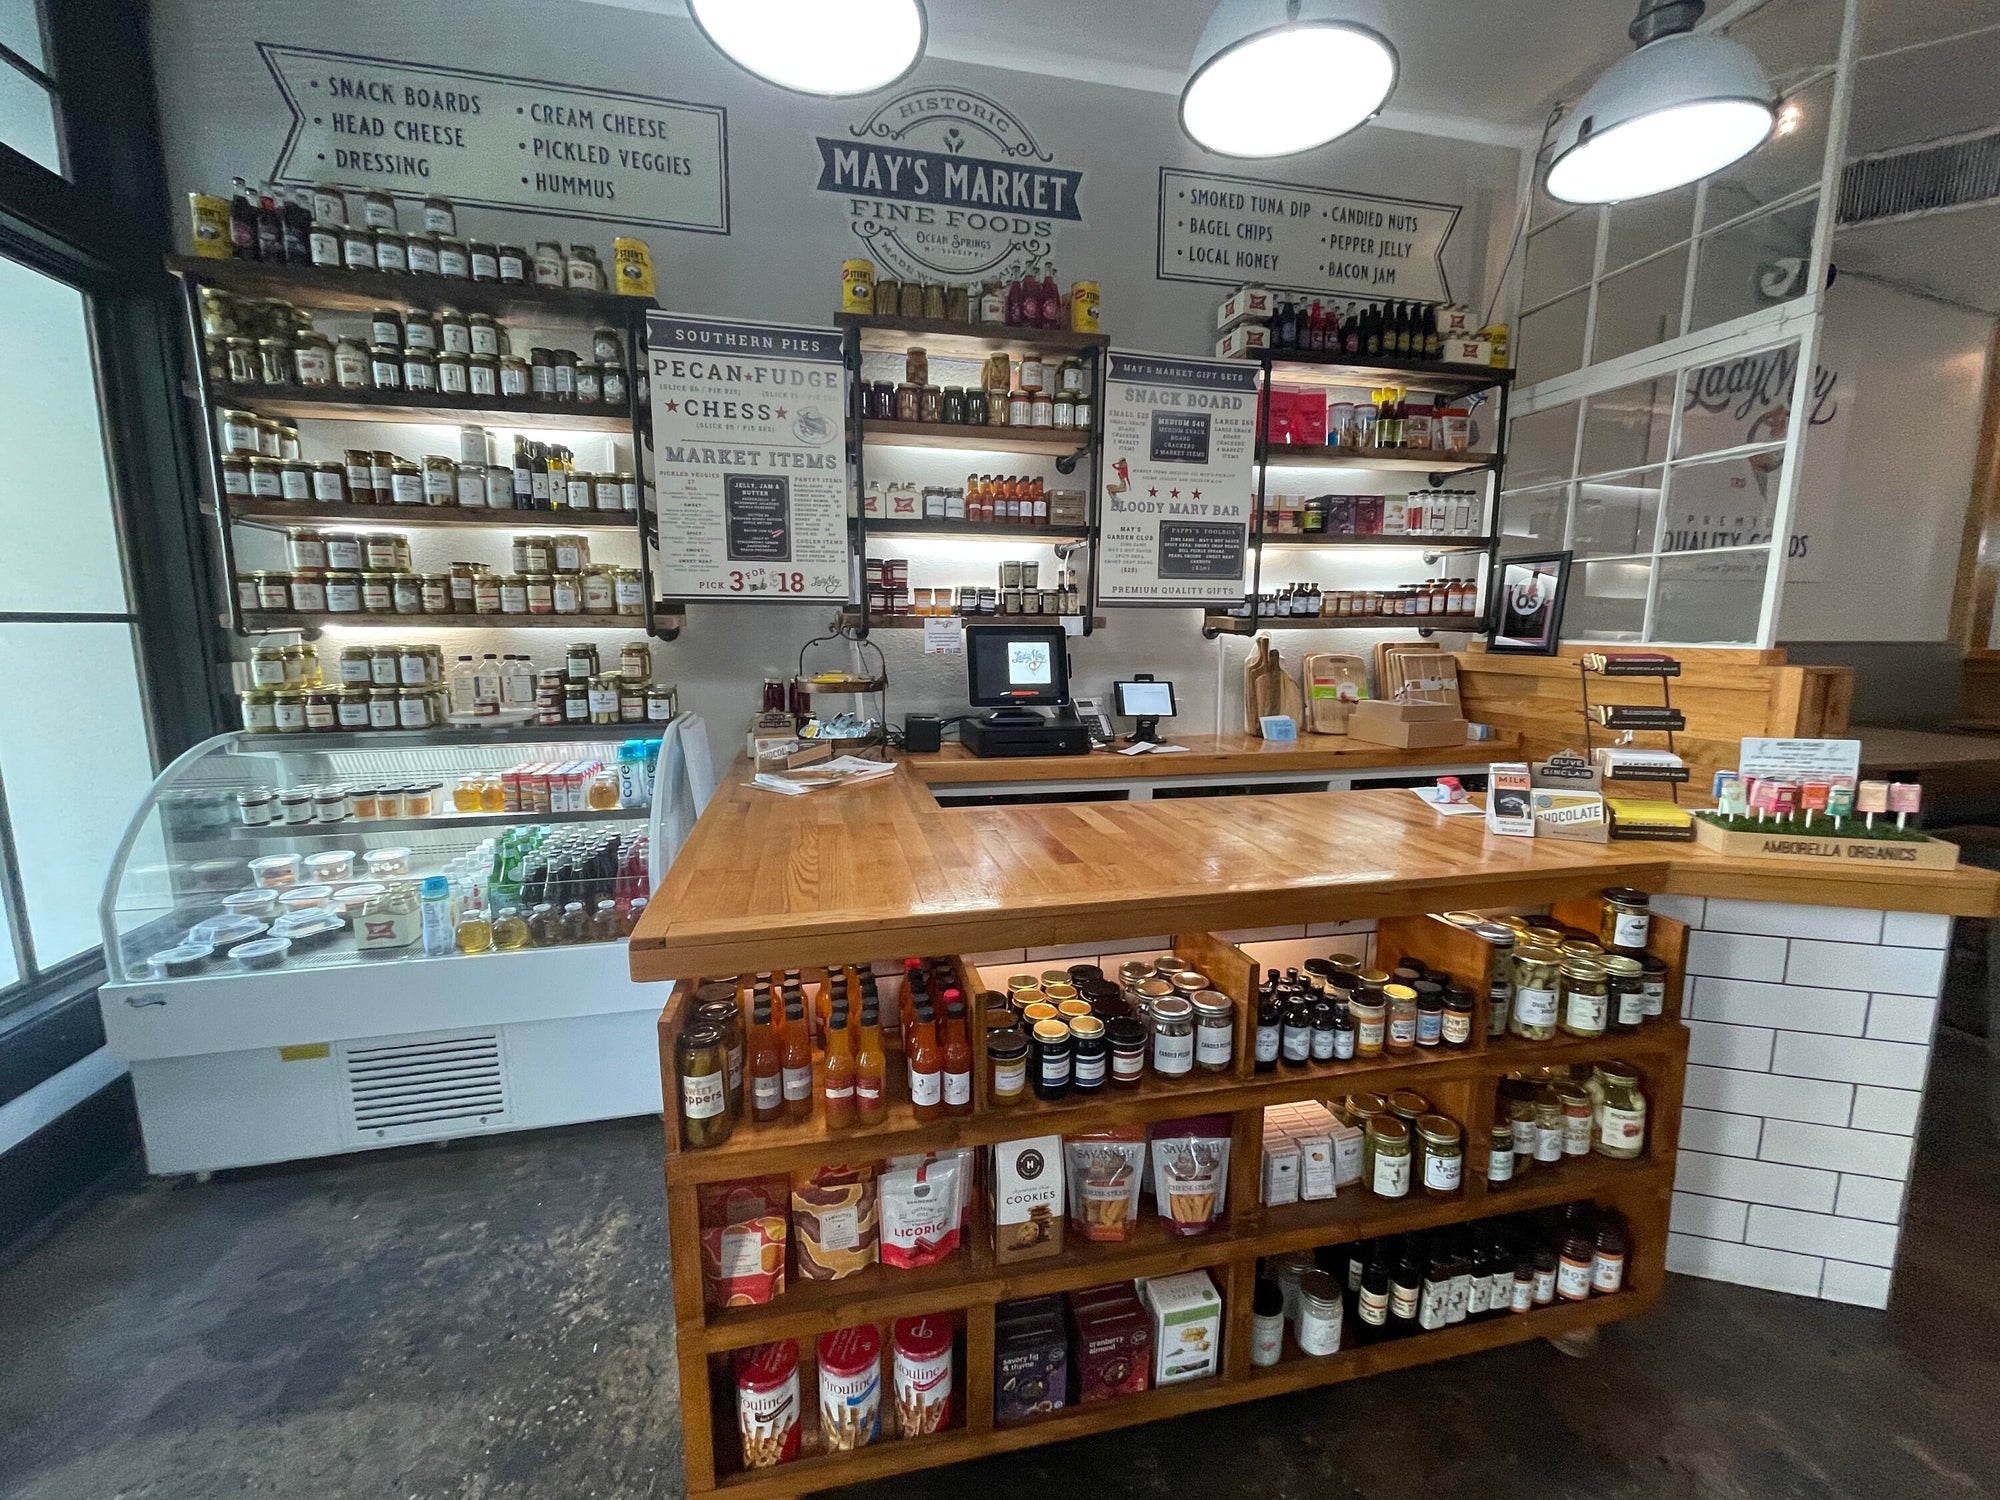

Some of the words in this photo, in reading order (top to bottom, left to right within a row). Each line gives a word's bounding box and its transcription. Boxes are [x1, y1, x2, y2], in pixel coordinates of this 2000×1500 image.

[329, 76, 395, 105] SNACK
[405, 86, 481, 115] BOARDS
[530, 104, 593, 130] CREAM
[602, 113, 667, 139] CHEESE
[898, 97, 1010, 133] HISTORIC
[332, 112, 385, 138] HEAD
[393, 121, 466, 148] CHEESE
[335, 149, 430, 178] DRESSING
[533, 138, 610, 166] PICKLED
[618, 149, 692, 176] VEGGIES
[535, 172, 615, 200] HUMMUS
[833, 148, 930, 196] MAY'S
[943, 161, 1068, 212] MARKET
[1190, 188, 1244, 210] SMOKED
[1250, 196, 1284, 216] TUNA
[1290, 200, 1311, 219] DIP
[850, 199, 935, 224] FINE
[946, 210, 1053, 238] FOODS
[1190, 217, 1230, 238] BAGEL
[1236, 222, 1273, 242] CHIPS
[1331, 207, 1384, 228] CANDIED
[1388, 214, 1418, 233] NUTS
[1330, 233, 1374, 254] PEPPER
[1377, 240, 1412, 259] JELLY
[1189, 246, 1230, 266] LOCAL
[1236, 251, 1279, 271] HONEY
[1328, 261, 1369, 280] BACON
[1372, 266, 1396, 285] JAM
[675, 329, 774, 349] SOUTHERN
[781, 339, 821, 352] PIES
[654, 359, 743, 382] PECAN
[754, 366, 839, 388] FUDGE
[1123, 363, 1152, 374] MAY'S
[1155, 366, 1194, 378] MARKET
[1196, 370, 1218, 380] GIFT
[1220, 372, 1244, 382] SETS
[684, 399, 771, 421] CHESS
[1124, 388, 1184, 405] SNACK
[1186, 393, 1243, 410] BOARD
[1158, 418, 1190, 427] MEDIUM
[665, 446, 761, 466] MARKET
[769, 451, 838, 470] ITEMS
[1110, 500, 1165, 514] BLOODY
[1168, 503, 1209, 516] MARY
[1212, 505, 1240, 517] BAR
[1171, 527, 1200, 535] PAPPY'S
[1660, 531, 1742, 552] QUALITY
[699, 581, 725, 589] PICK
[729, 570, 744, 591] 3
[745, 567, 766, 579] FOR
[1112, 585, 1158, 594] PREMIUM
[1161, 586, 1204, 595] QUALITY
[1206, 587, 1235, 595] GIFTS
[621, 765, 633, 798] core
[1498, 776, 1527, 784] MILK
[1543, 769, 1592, 778] SINCLAIR
[1762, 840, 1841, 858] AMBORELLA
[1847, 845, 1917, 861] ORGANICS
[1077, 1149, 1135, 1160] SAVANNAH
[1163, 1143, 1220, 1154] SAVANNAH
[1026, 1160, 1034, 1169] H
[1006, 1190, 1056, 1205] COOKIES
[1089, 1336, 1124, 1348] cranberry
[1089, 1343, 1116, 1354] almond
[1003, 1354, 1028, 1366] savory
[1029, 1353, 1039, 1362] fig
[1011, 1361, 1035, 1372] thyme
